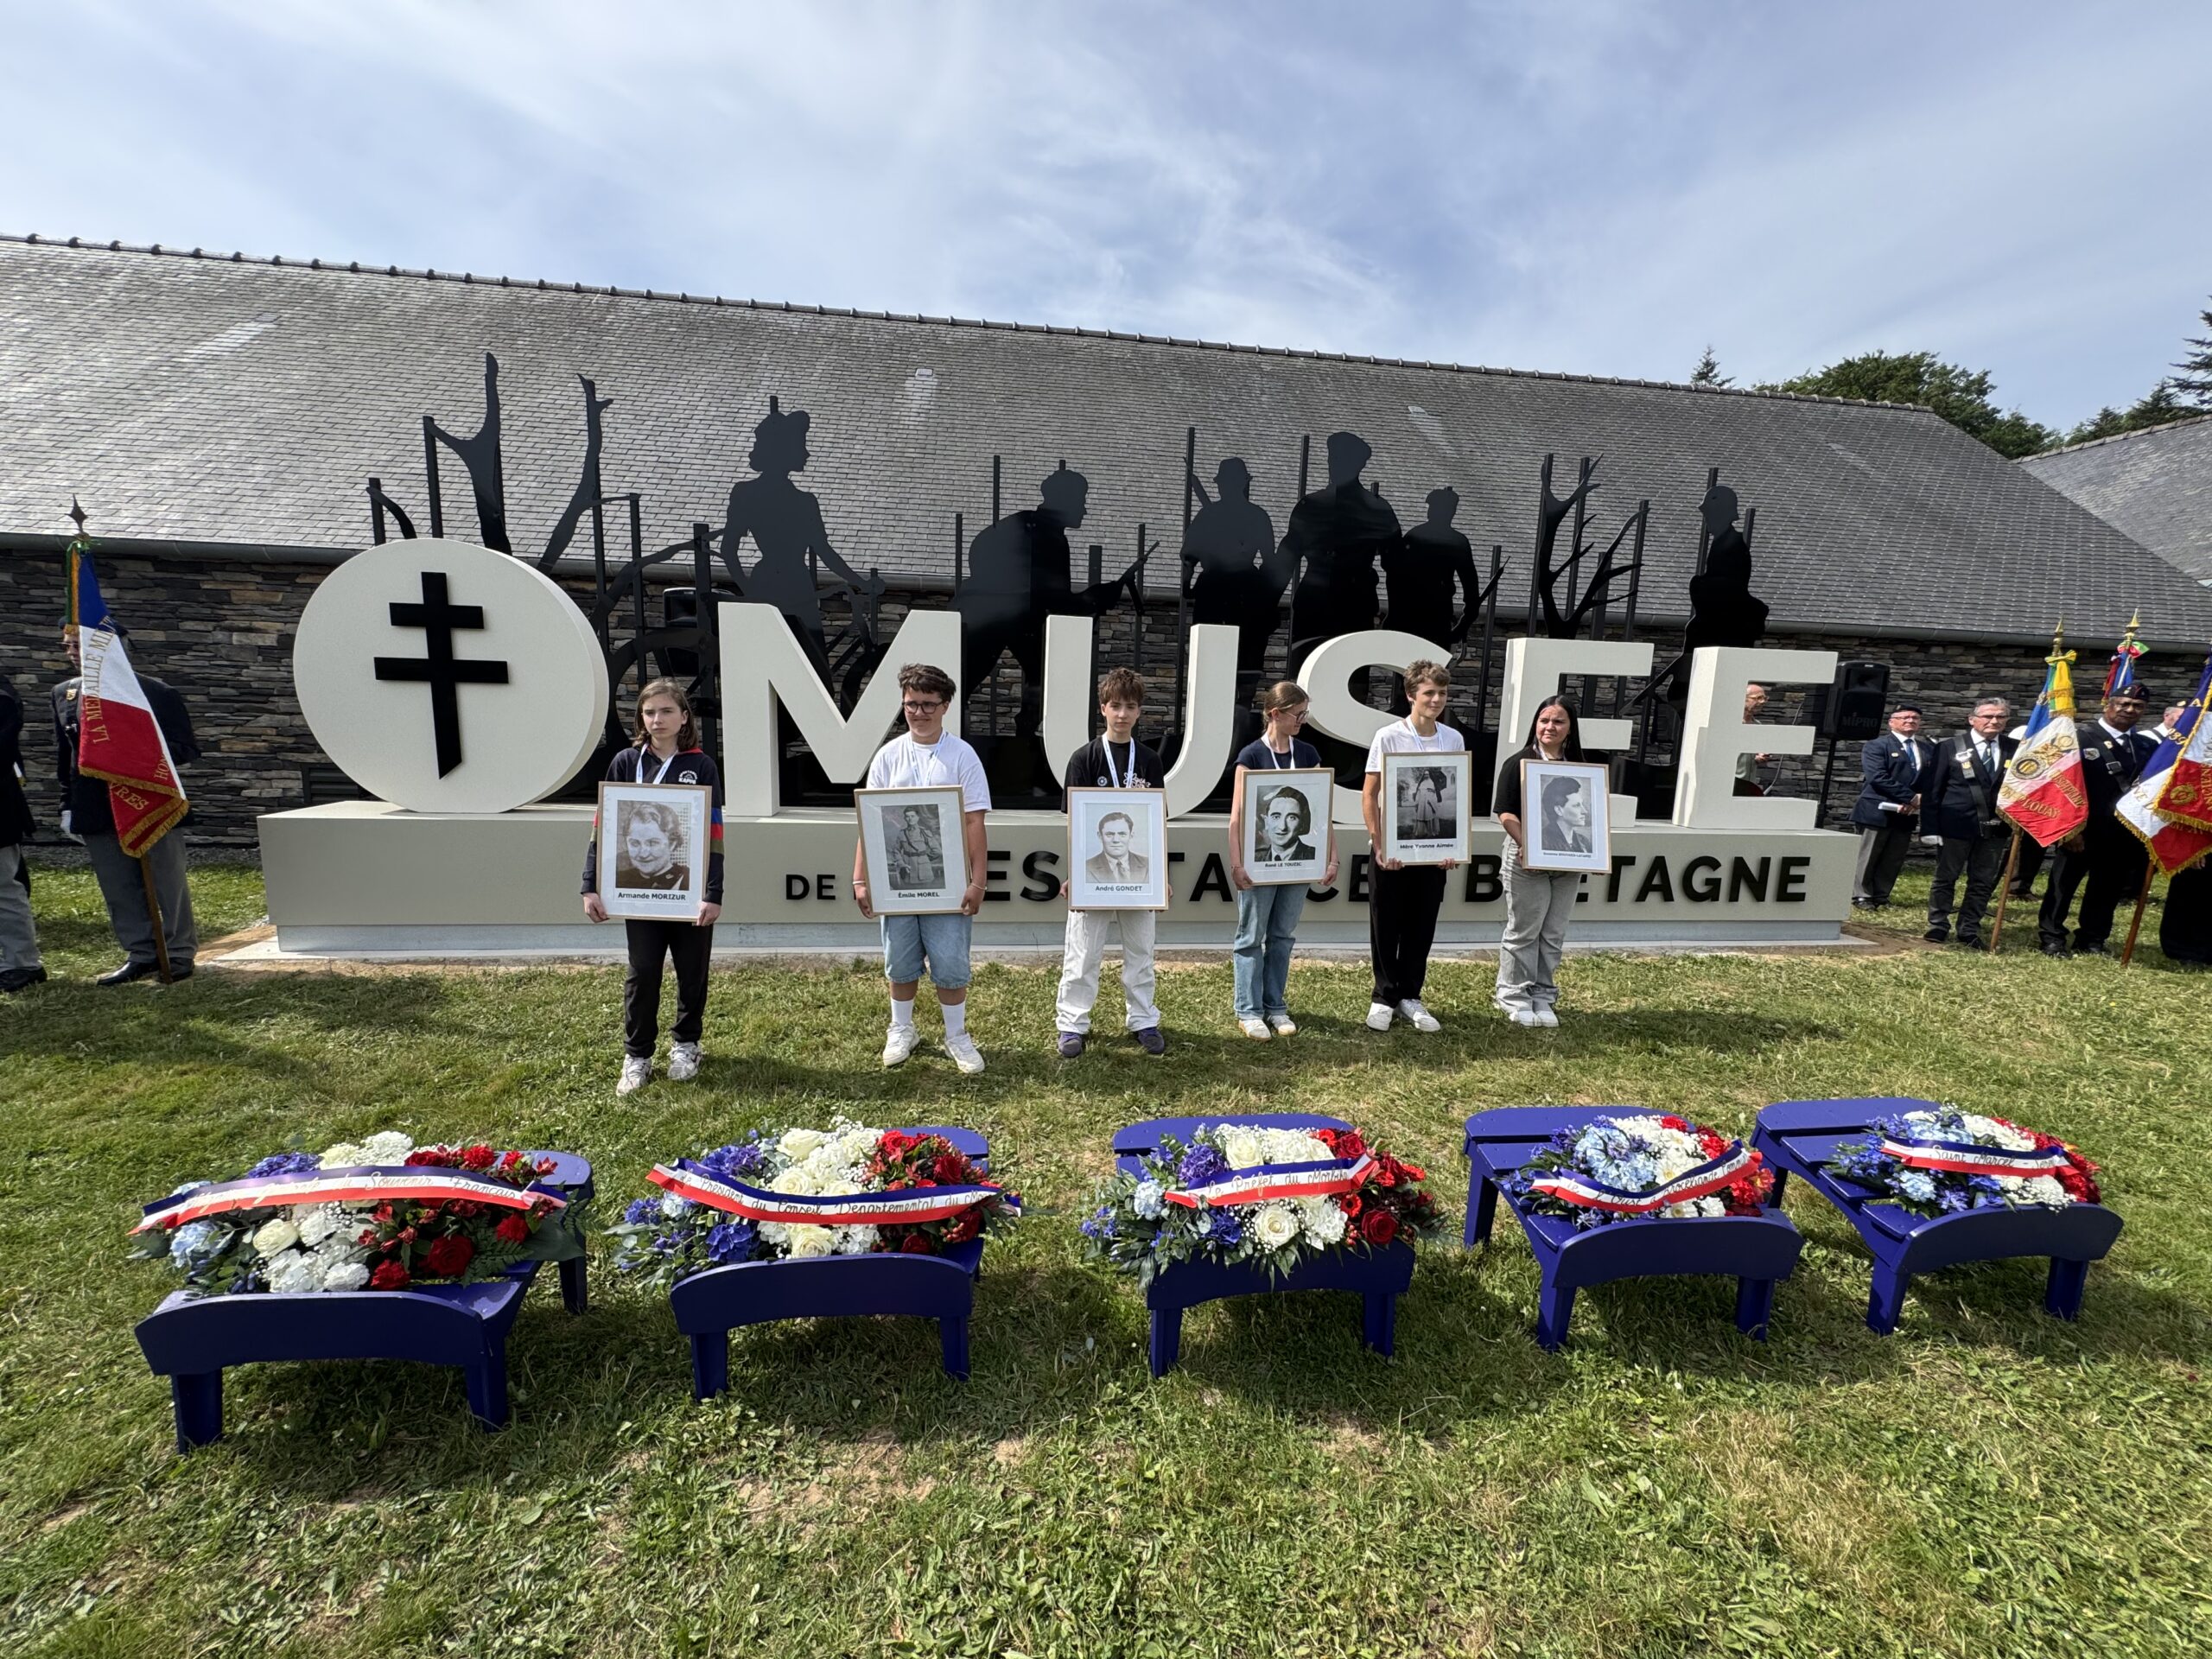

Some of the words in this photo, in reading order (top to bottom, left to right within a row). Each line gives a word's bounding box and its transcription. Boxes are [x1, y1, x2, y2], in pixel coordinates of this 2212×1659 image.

[717, 601, 1838, 830] MUSEE
[785, 873, 836, 900] DE
[1974, 1153, 2016, 1166] Marcel
[365, 1171, 433, 1190] Souvenir
[448, 1174, 517, 1199] Français
[1231, 1171, 1275, 1197] Préfet
[1284, 1172, 1299, 1185] du
[751, 1198, 768, 1211] du
[777, 1198, 823, 1215] Conseil
[944, 1193, 959, 1206] du
